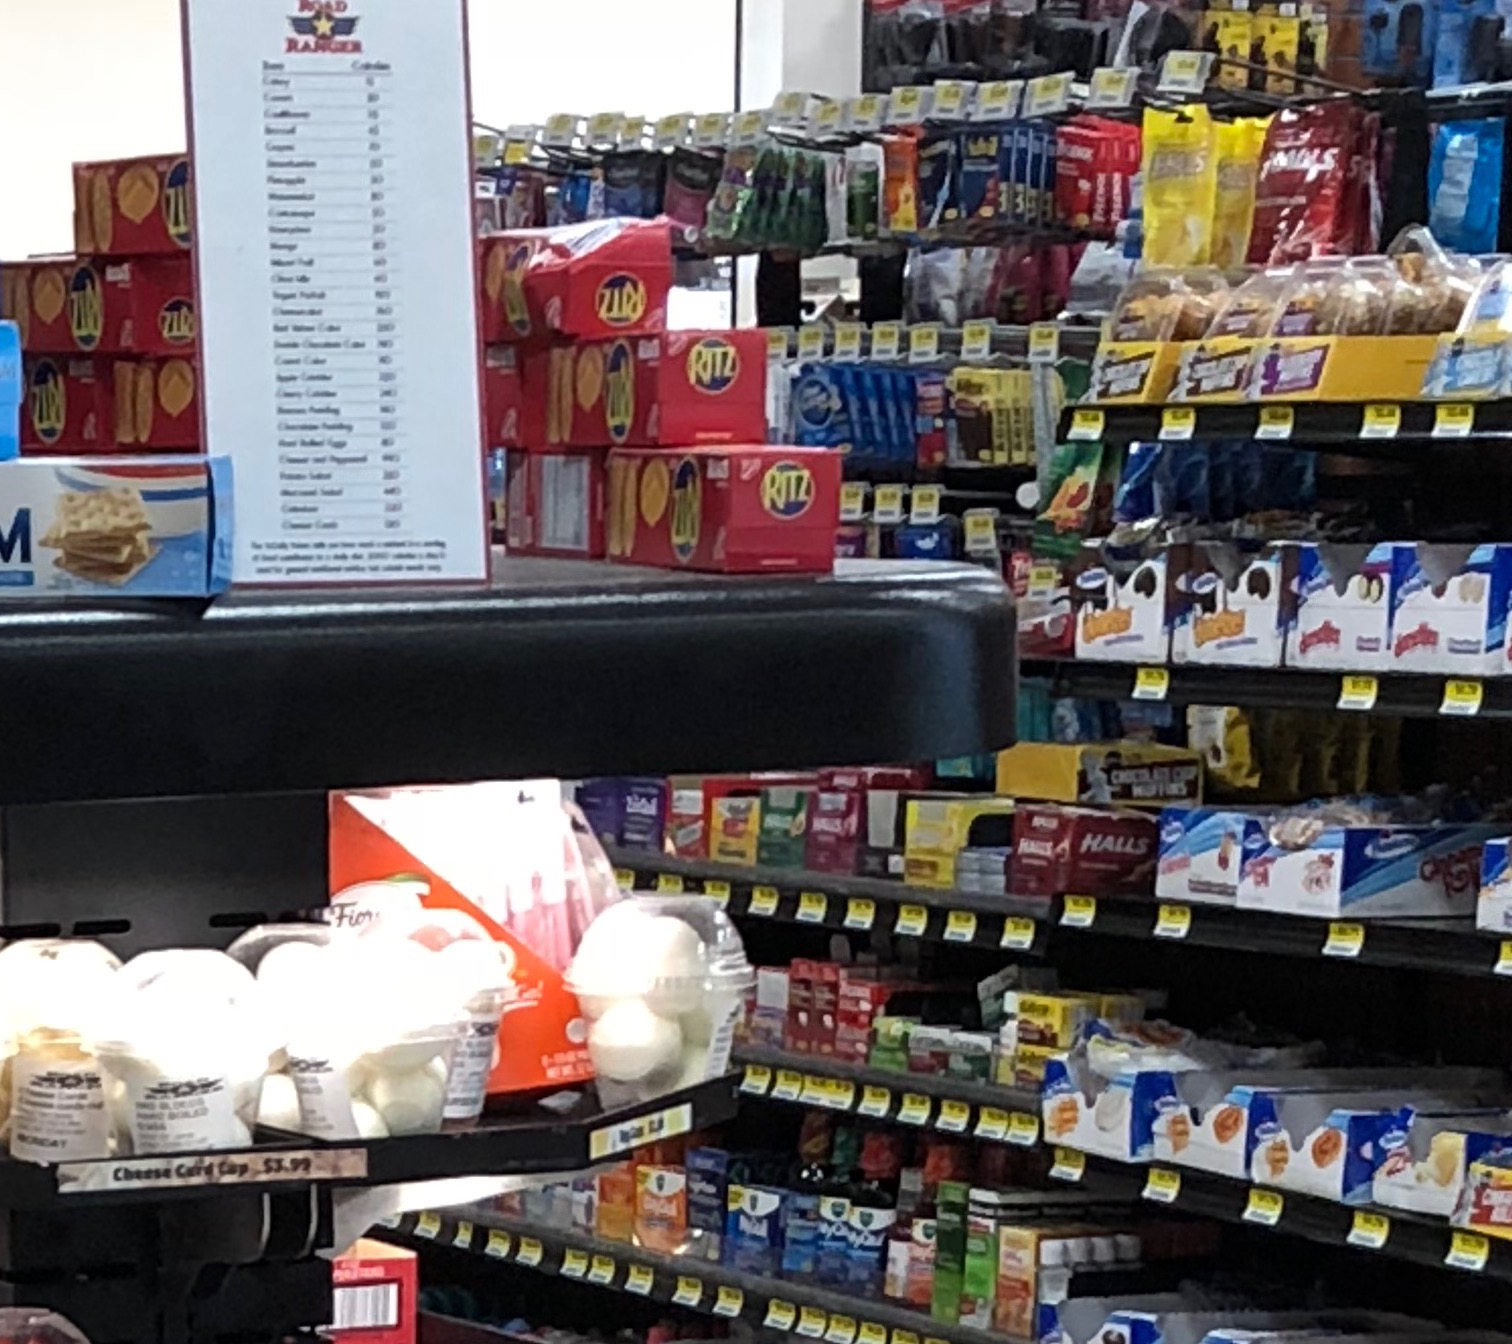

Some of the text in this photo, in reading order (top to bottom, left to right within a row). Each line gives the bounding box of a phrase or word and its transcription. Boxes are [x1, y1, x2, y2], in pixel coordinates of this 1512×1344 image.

[285, 38, 363, 53] RANGER
[598, 282, 646, 323] RITZ
[688, 344, 738, 386] RITZ
[762, 470, 812, 513] RITZ
[1080, 832, 1149, 854] HALLS
[113, 1166, 171, 1182] Cheese
[175, 1162, 213, 1179] Curd
[263, 1156, 311, 1174] $3.99
